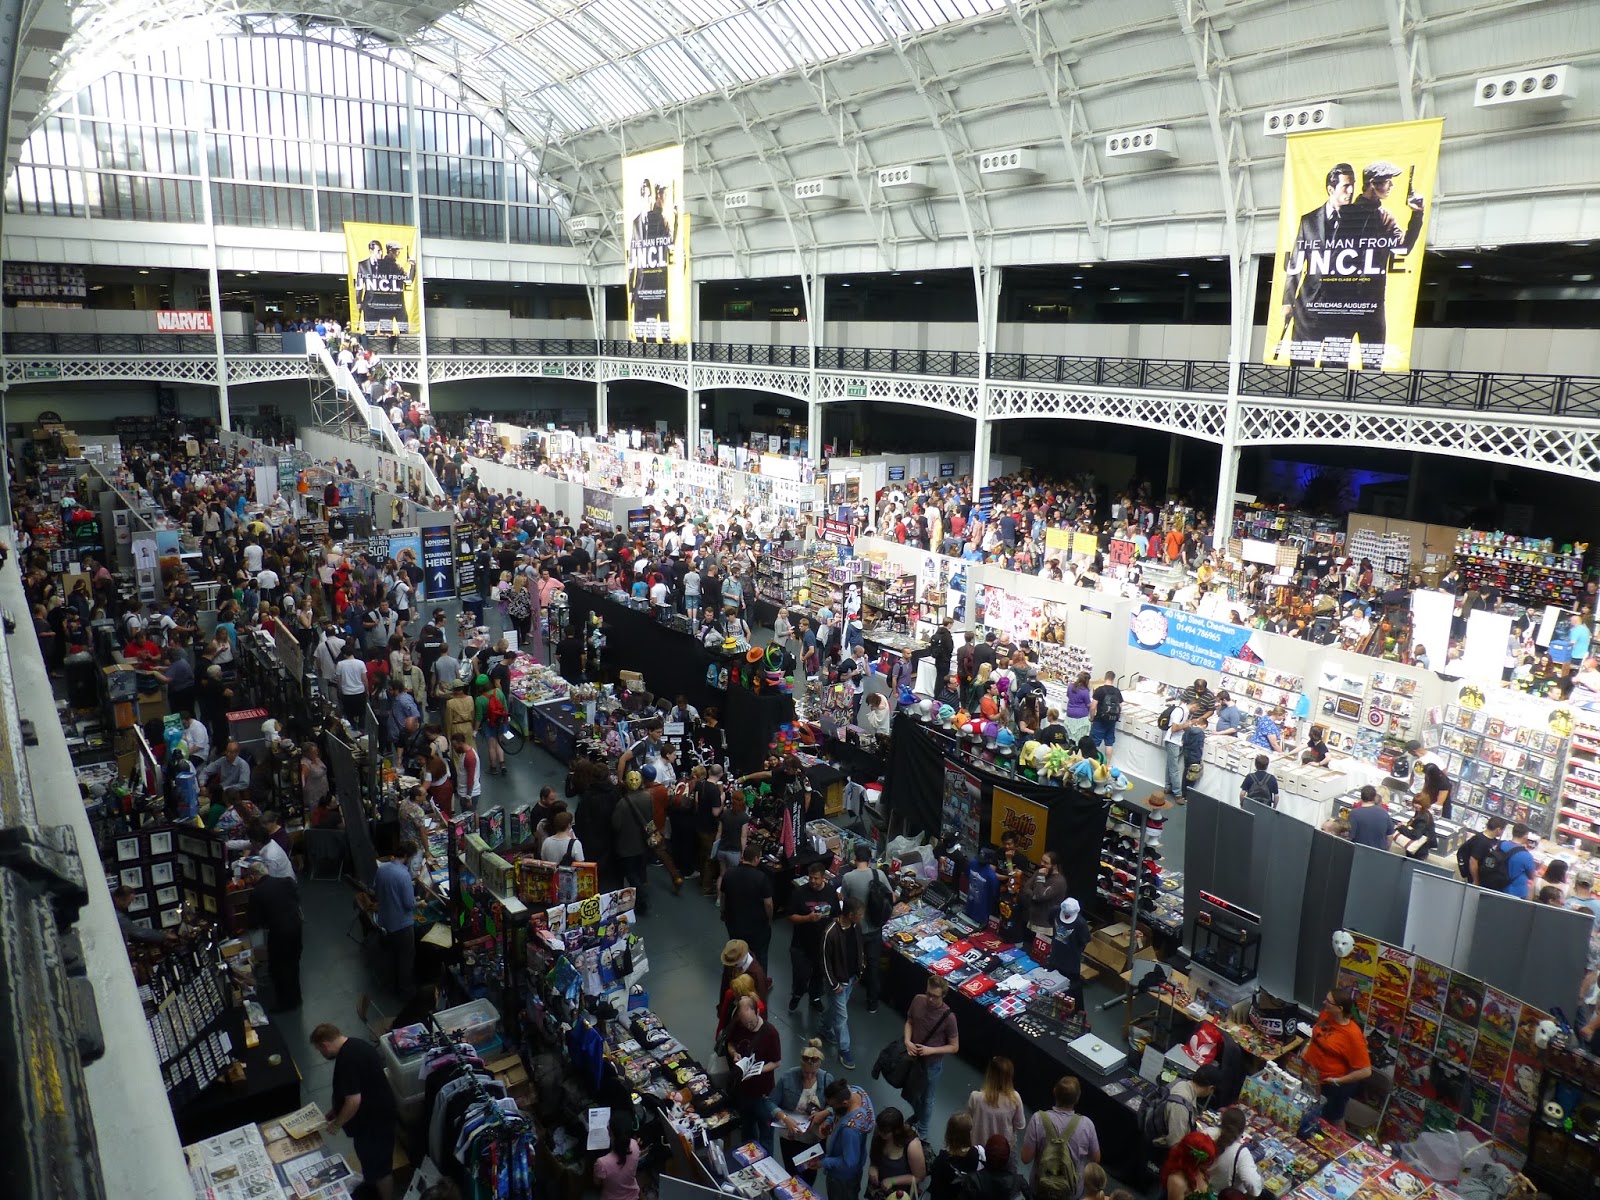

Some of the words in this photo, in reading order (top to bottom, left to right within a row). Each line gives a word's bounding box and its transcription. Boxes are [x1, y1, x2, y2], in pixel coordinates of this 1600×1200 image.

[632, 239, 642, 249] THE
[1297, 239, 1321, 250] THE
[1325, 238, 1355, 249] MAN
[1358, 237, 1398, 248] FROM
[157, 312, 211, 330] MARVEL
[368, 546, 390, 557] SLOTH
[425, 557, 452, 568] HERE
[1175, 610, 1188, 623] High
[1170, 648, 1190, 661] 01525
[1036, 939, 1047, 951] £15
[286, 1107, 317, 1127] MARTIANS
